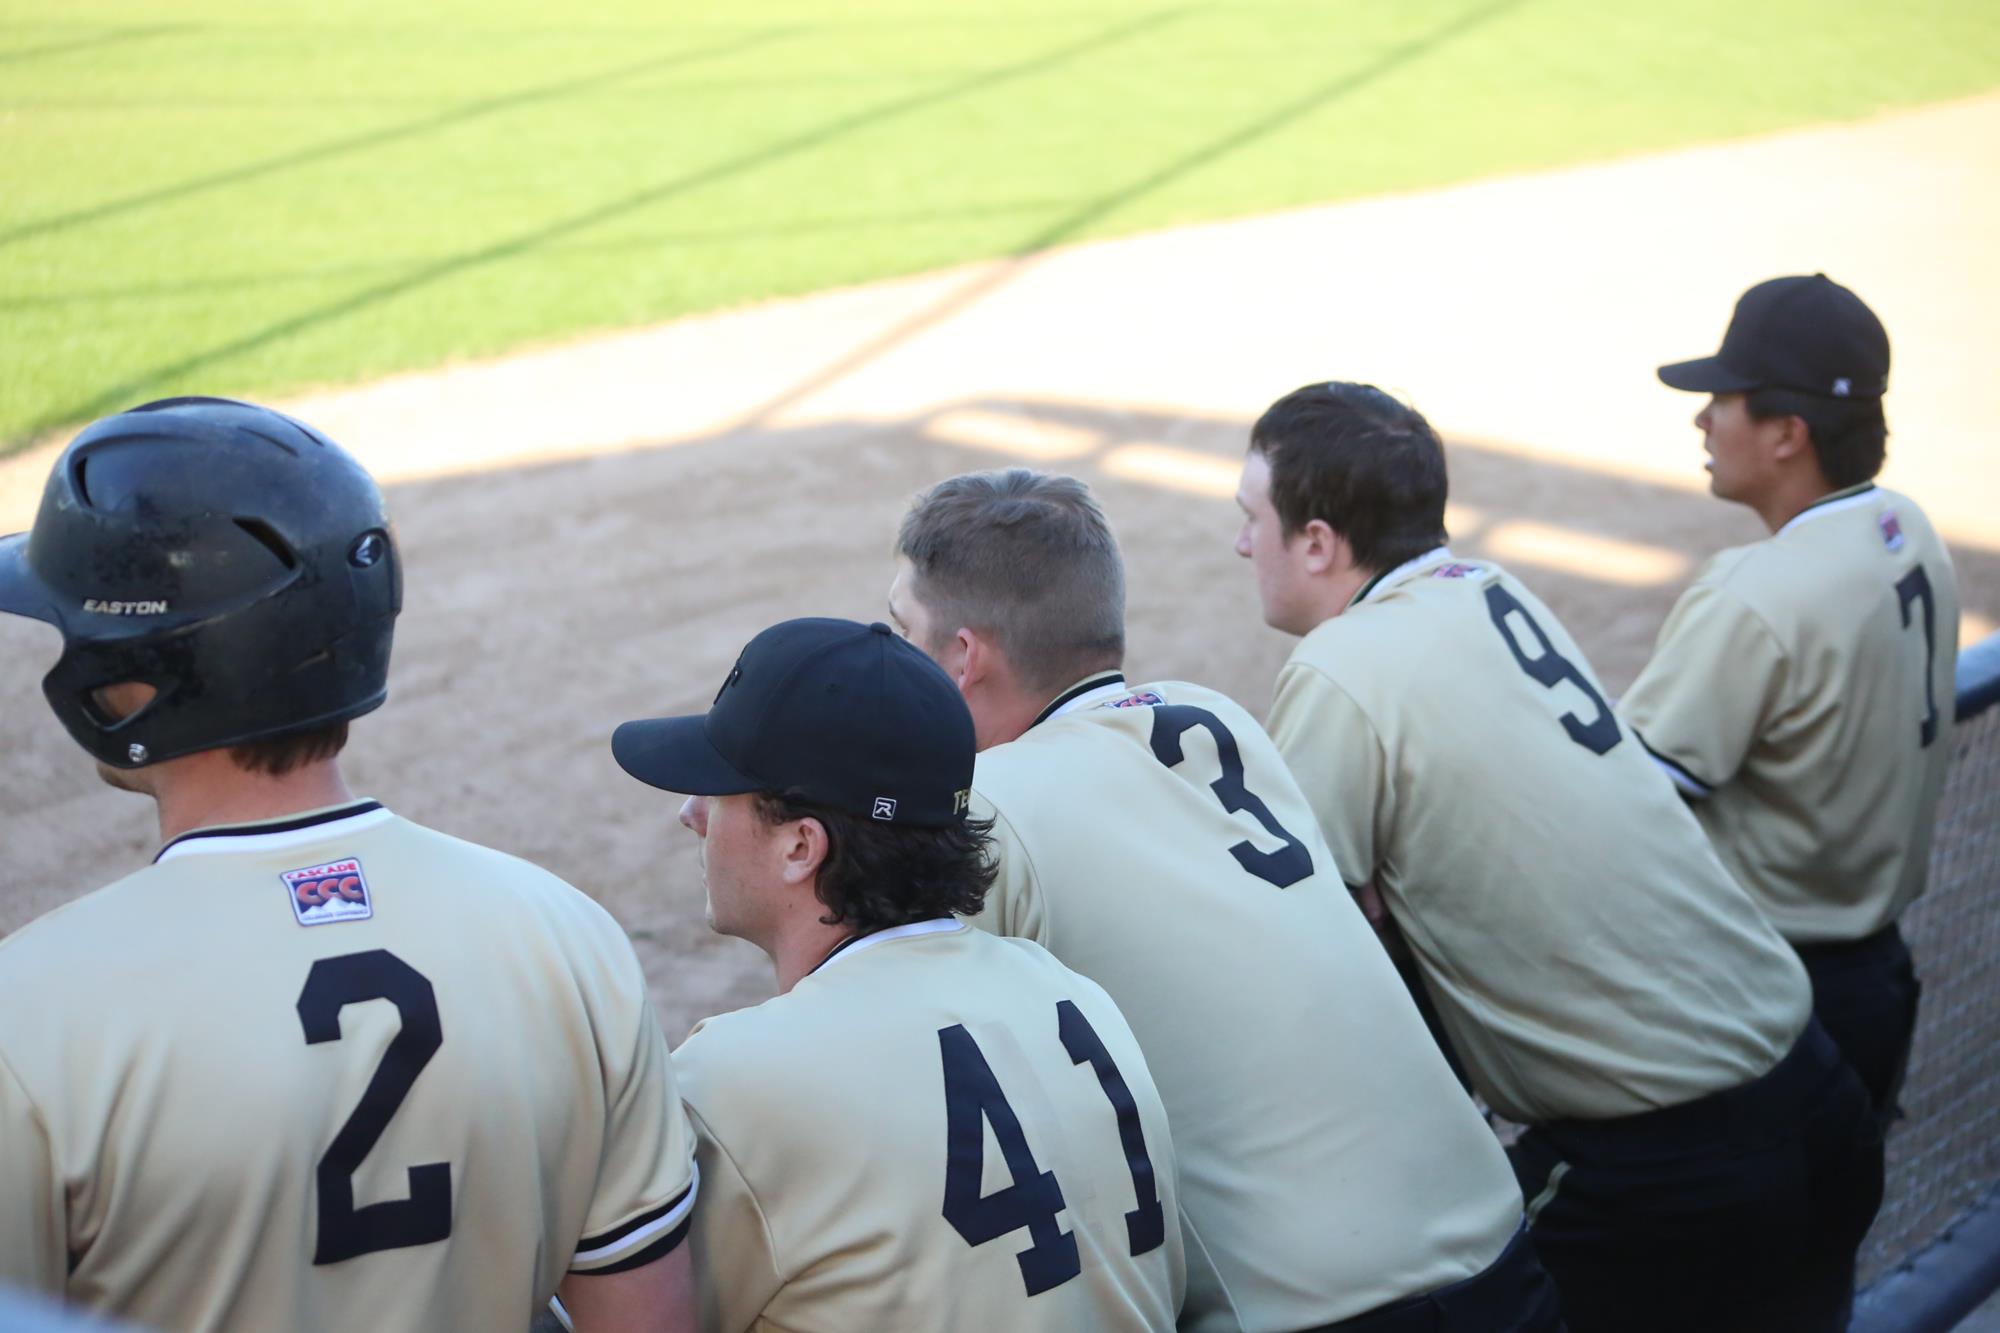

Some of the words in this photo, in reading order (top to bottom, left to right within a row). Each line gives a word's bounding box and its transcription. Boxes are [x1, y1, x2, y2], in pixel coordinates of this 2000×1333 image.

[83, 599, 168, 615] EASTON
[1484, 582, 1622, 756] 9
[1894, 562, 1939, 748] 7
[287, 863, 357, 880] CASCADE
[1150, 704, 1314, 889] 3
[296, 876, 364, 905] CCC
[296, 949, 452, 1266] 2
[937, 1000, 1165, 1298] 41
